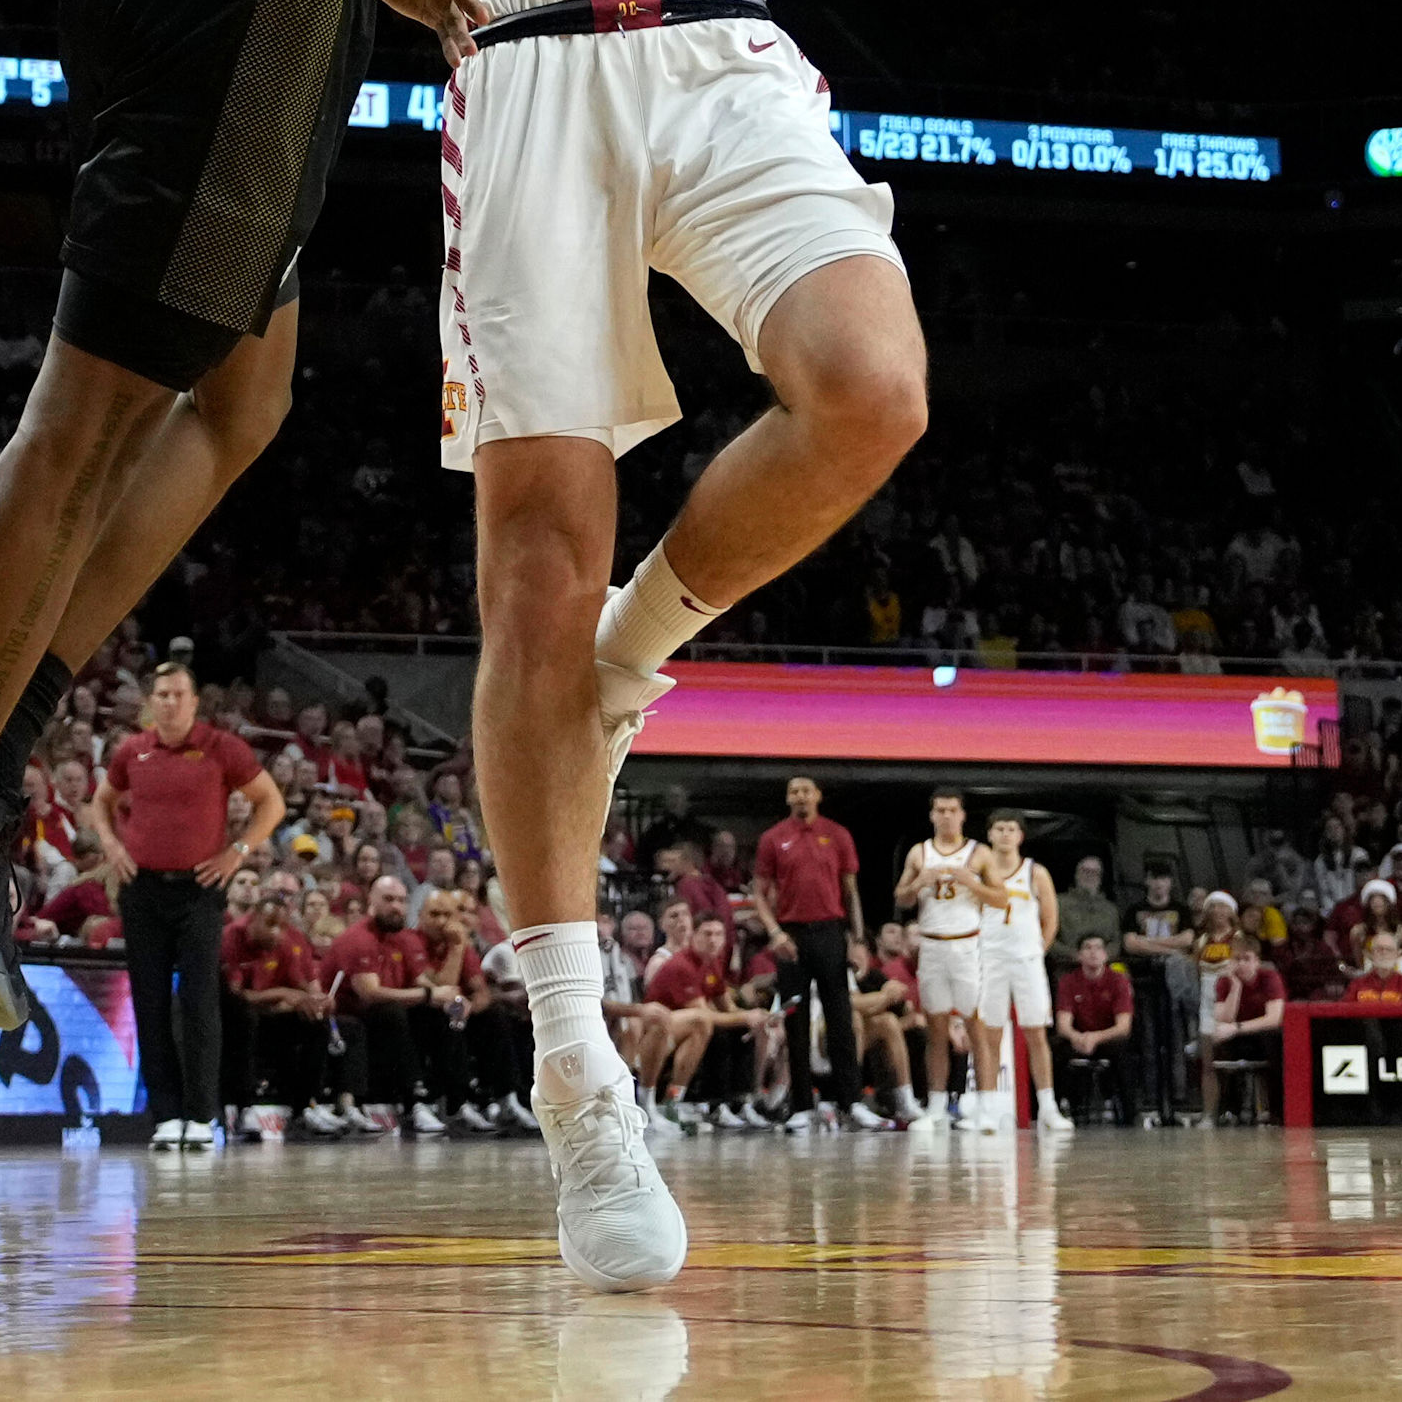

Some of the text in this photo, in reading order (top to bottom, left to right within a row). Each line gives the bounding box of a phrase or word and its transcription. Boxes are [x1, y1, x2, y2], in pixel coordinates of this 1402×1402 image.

[859, 129, 995, 165] 5/23 21.7%
[1012, 138, 1131, 173] 0/13 0.0%
[1154, 148, 1270, 181] 1/4 25.0%
